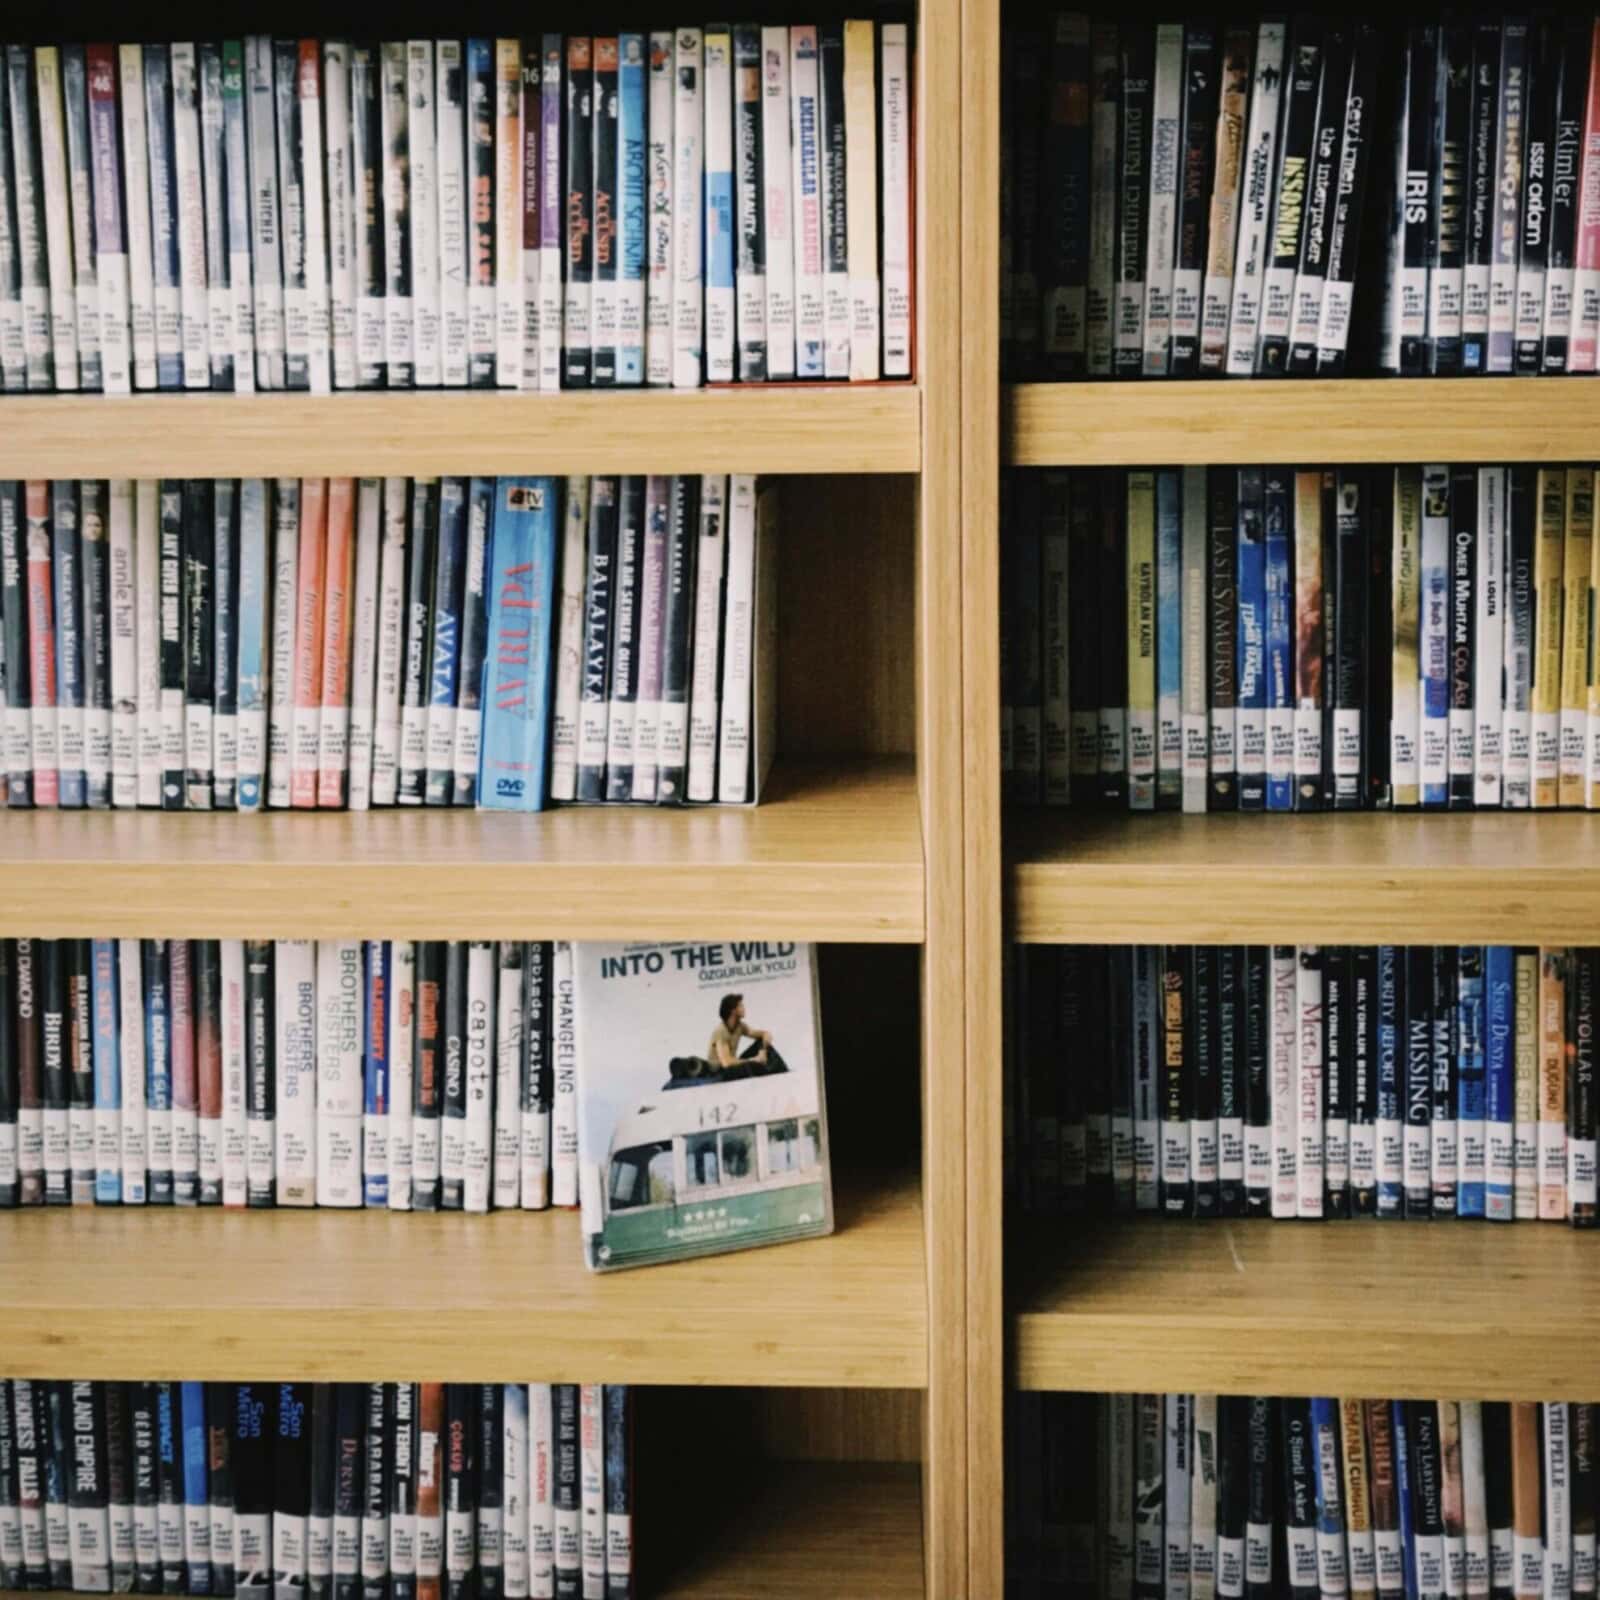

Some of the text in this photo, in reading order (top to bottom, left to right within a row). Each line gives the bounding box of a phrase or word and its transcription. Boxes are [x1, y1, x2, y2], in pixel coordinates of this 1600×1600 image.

[885, 77, 902, 143] Elephant
[1319, 127, 1335, 156] the
[1555, 119, 1580, 206] iklimler
[744, 183, 757, 234] BEAUTY
[1275, 156, 1306, 256] INSOMNIA
[1406, 169, 1428, 224] IRIS
[162, 532, 178, 557] ANY
[1454, 531, 1472, 576] ÖMER
[115, 547, 132, 638] annie hall
[1212, 525, 1233, 696] LAST SAMURAI
[1454, 579, 1470, 643] MUHTAR
[1487, 580, 1496, 616] LOLITA
[1513, 557, 1529, 603] LORD
[433, 608, 457, 705] AVATA
[585, 554, 609, 703] BALALAYKA
[18, 956, 33, 1019] DIAMOND
[601, 941, 796, 979] INTO THE WILD
[766, 959, 797, 974] YOLU
[152, 983, 165, 1009] THE
[298, 982, 312, 1072] BROTHERS
[340, 949, 357, 1053] BROTHERS
[1516, 969, 1535, 1082] mona lisa
[44, 1012, 62, 1070] BIRDY
[152, 1014, 166, 1074] BOURNE
[446, 1036, 459, 1097] CASINO
[469, 999, 487, 1101] capote
[557, 980, 574, 1094] CHANGELING
[1220, 1002, 1234, 1116] REVOLUTIONS
[1381, 1024, 1395, 1085] REPORT
[1434, 1019, 1450, 1091] MARS
[1578, 1014, 1592, 1083] YOLLAR
[1409, 1019, 1429, 1121] MISSING
[134, 1410, 151, 1449] DEAD
[157, 1392, 173, 1464] IMPACT
[237, 1386, 252, 1439] Metro
[251, 1402, 264, 1438] Son
[279, 1384, 293, 1436] Metro
[291, 1402, 304, 1438] Son
[396, 1382, 411, 1420] AKIN
[1344, 1401, 1361, 1463] SMANLI
[14, 1381, 39, 1500] ARKNESS FALLS
[72, 1381, 97, 1492] NLAND EMPIRE
[369, 1381, 384, 1520] VRİM ARABALA
[1550, 1440, 1565, 1487] PELLE
[1421, 1455, 1437, 1525] LABYRINTH
